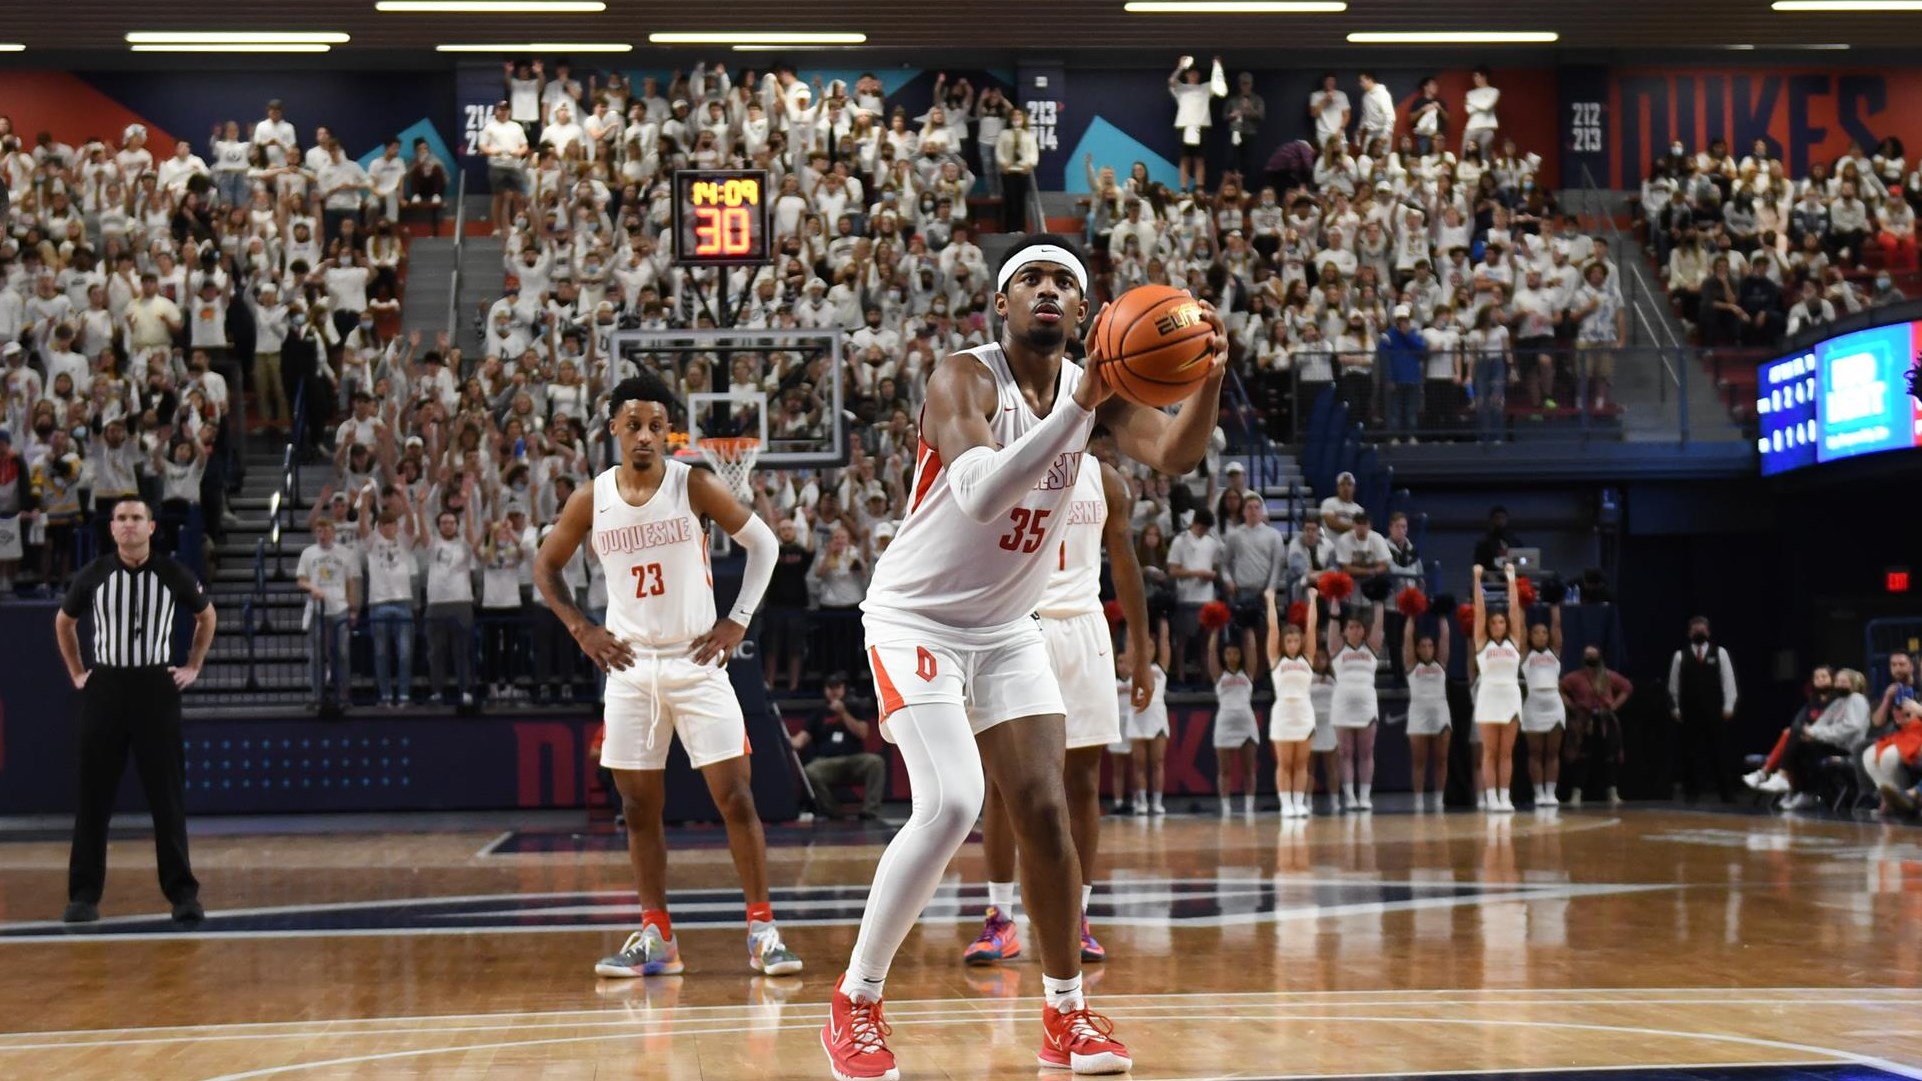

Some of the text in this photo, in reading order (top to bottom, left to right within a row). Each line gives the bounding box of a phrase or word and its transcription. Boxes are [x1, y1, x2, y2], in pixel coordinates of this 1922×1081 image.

[1027, 101, 1057, 125] 213
[1572, 103, 1601, 125] 212
[1573, 128, 1601, 151] 213
[693, 179, 758, 207] 14:09
[695, 207, 750, 255] 30
[597, 516, 692, 556] DUQUESNE
[999, 507, 1052, 553] 35
[631, 562, 666, 599] 23
